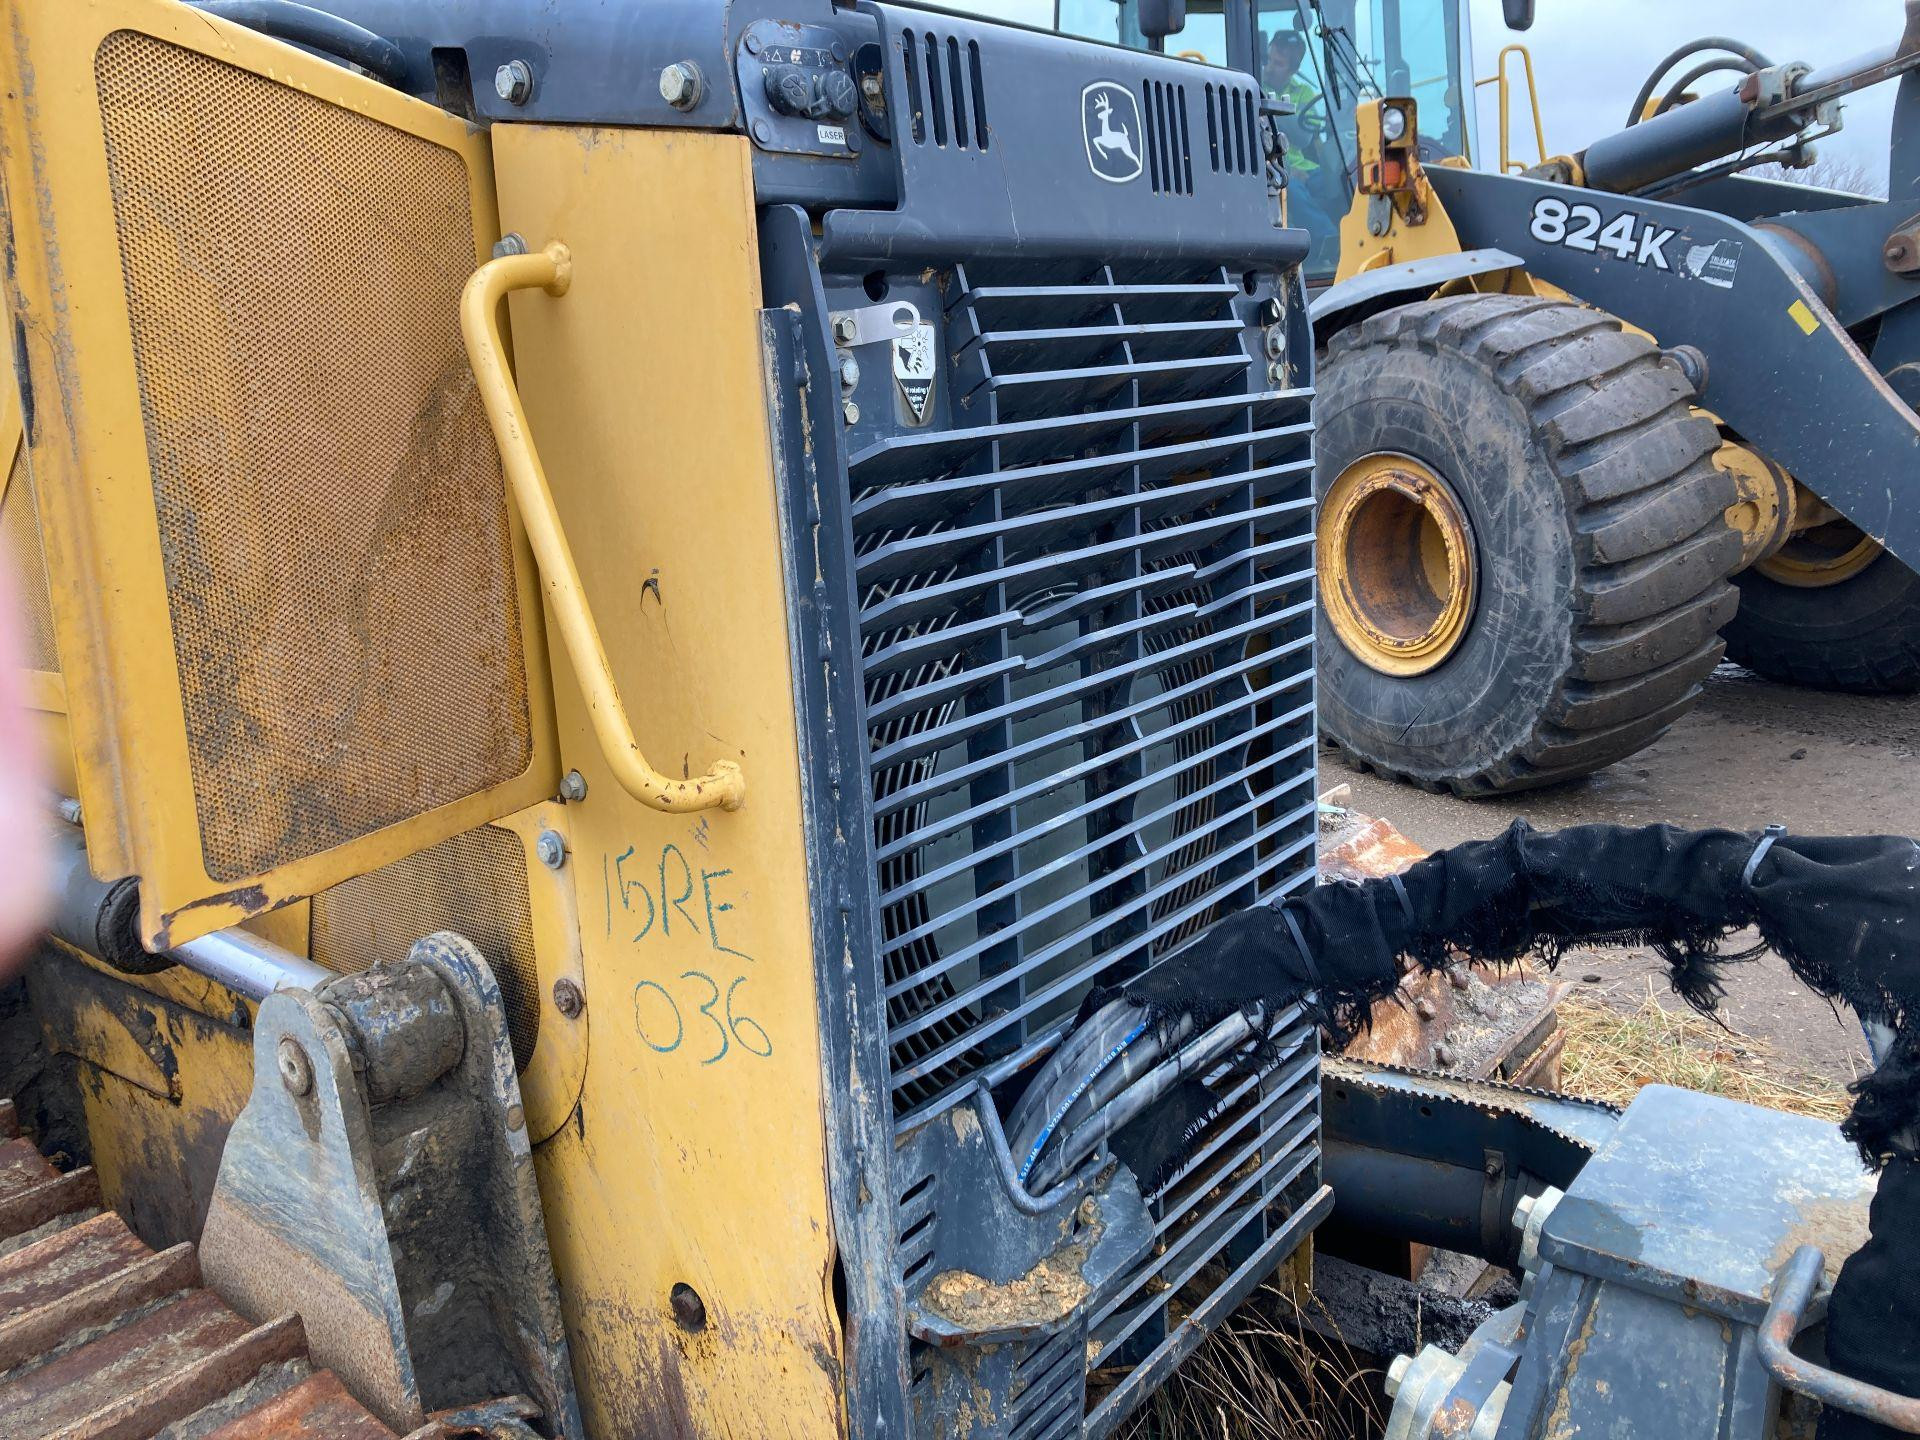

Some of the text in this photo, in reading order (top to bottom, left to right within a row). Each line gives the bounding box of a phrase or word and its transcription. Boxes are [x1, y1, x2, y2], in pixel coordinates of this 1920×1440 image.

[819, 130, 845, 140] LASER
[1529, 197, 1678, 270] 824K
[603, 843, 755, 963] 15RE
[634, 970, 773, 1067] 036
[1061, 1099, 1073, 1112] 100
